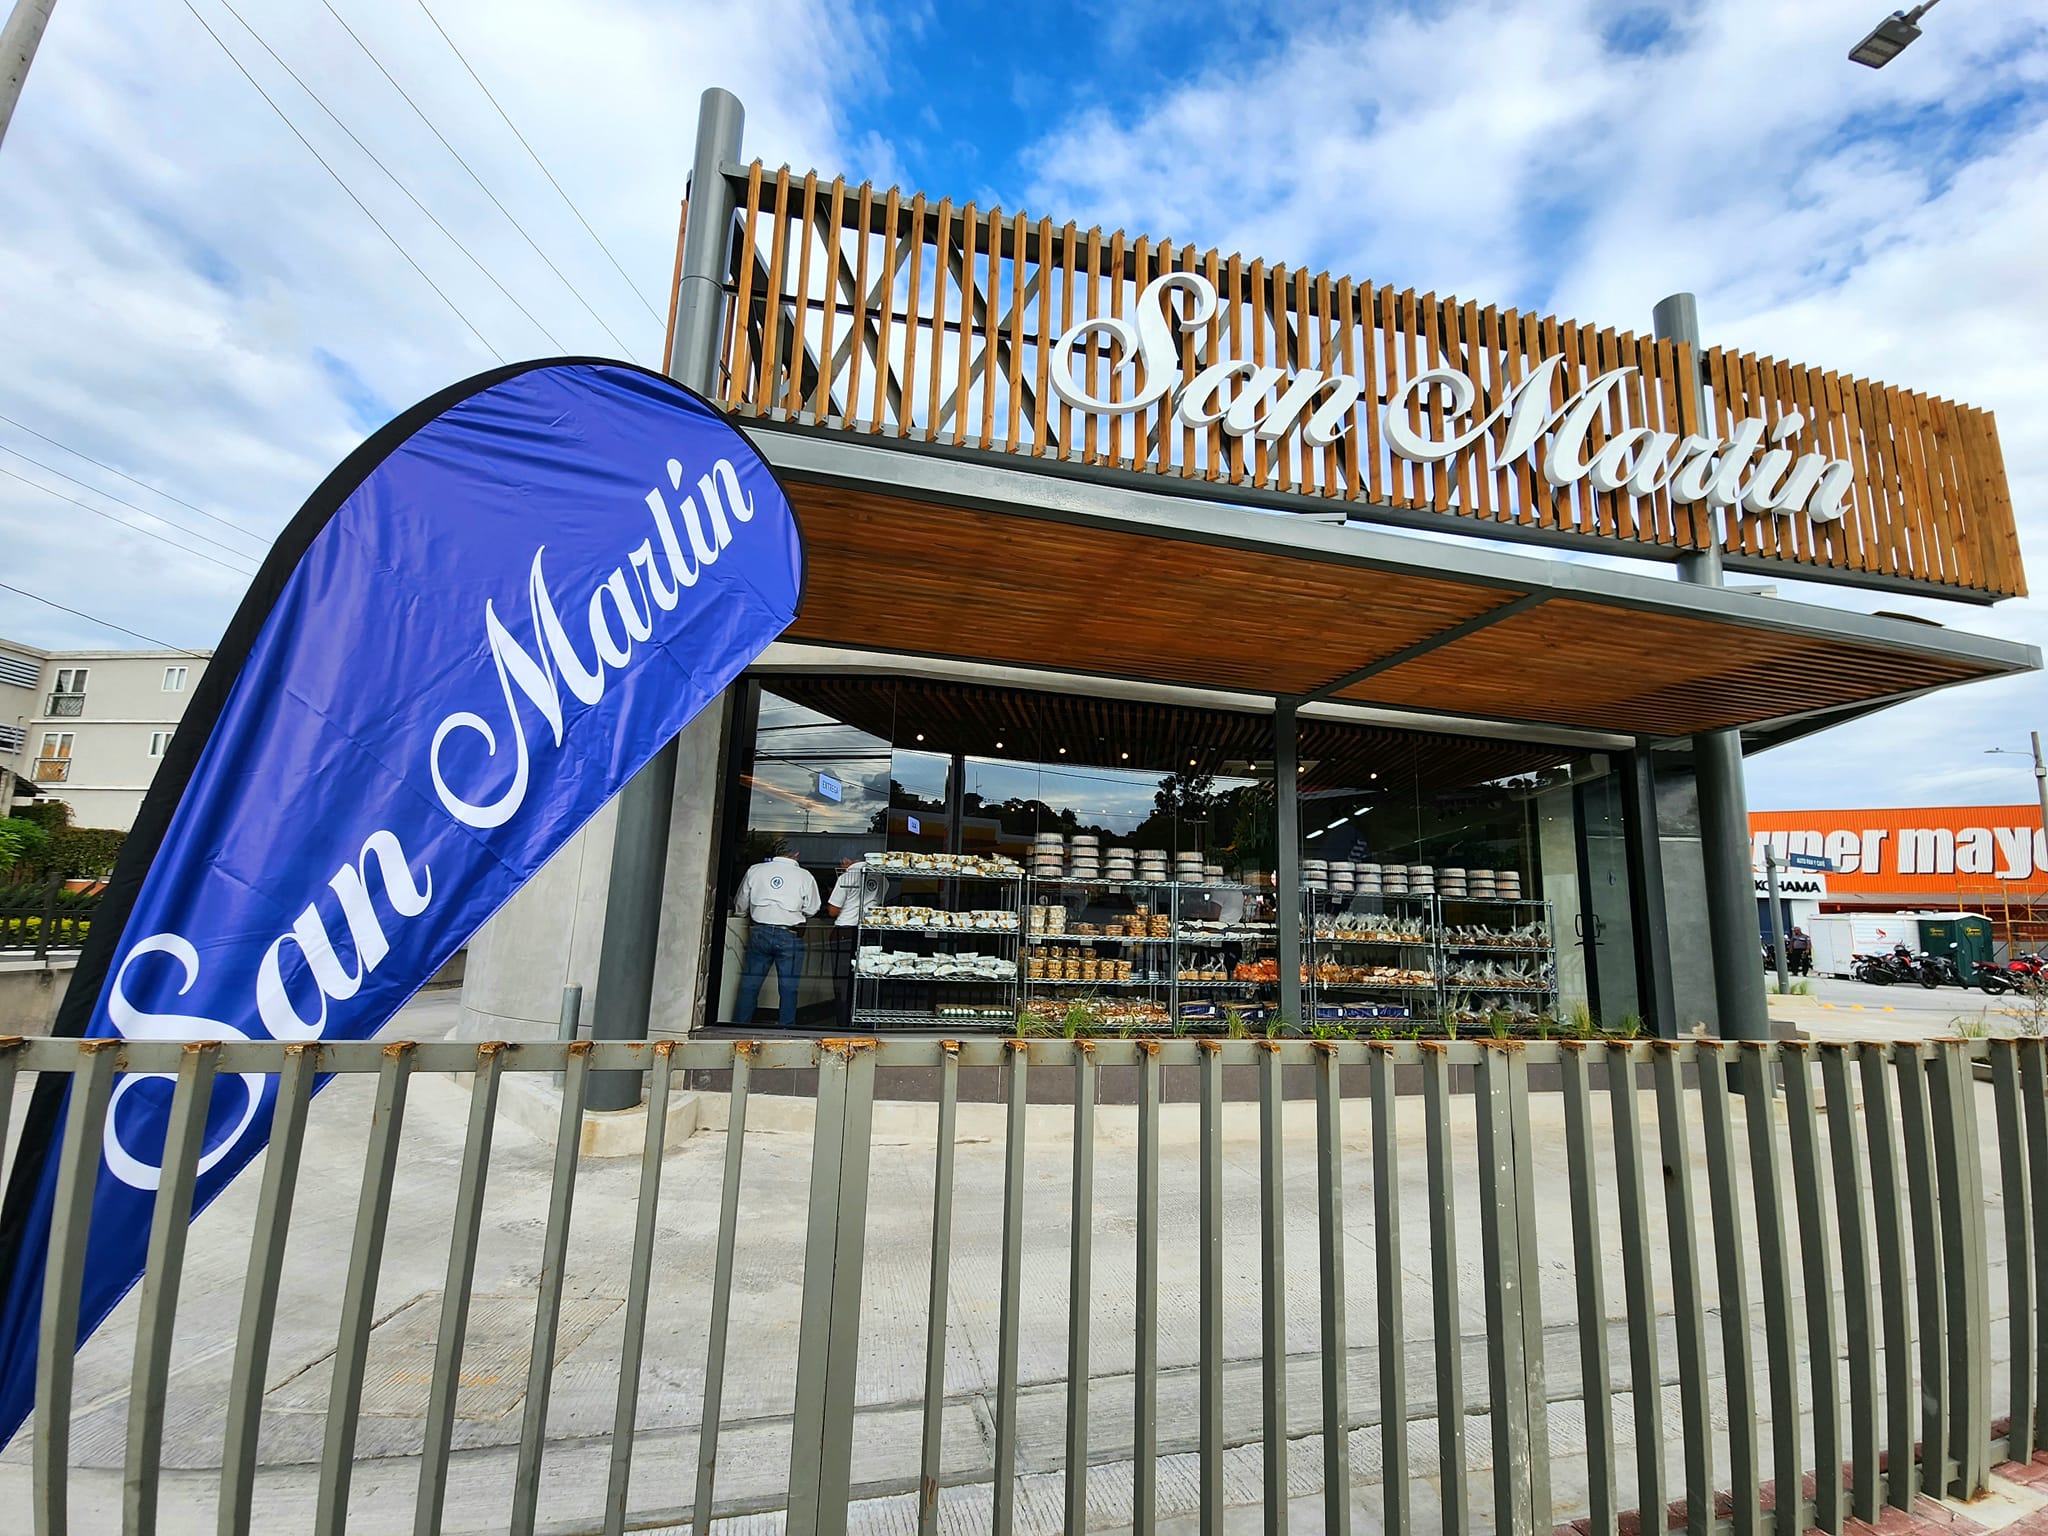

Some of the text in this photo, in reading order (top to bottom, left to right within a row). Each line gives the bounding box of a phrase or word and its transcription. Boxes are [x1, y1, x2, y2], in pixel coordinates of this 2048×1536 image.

[1051, 271, 1361, 447] San
[1751, 829, 1889, 874] uper
[103, 830, 432, 1190] San
